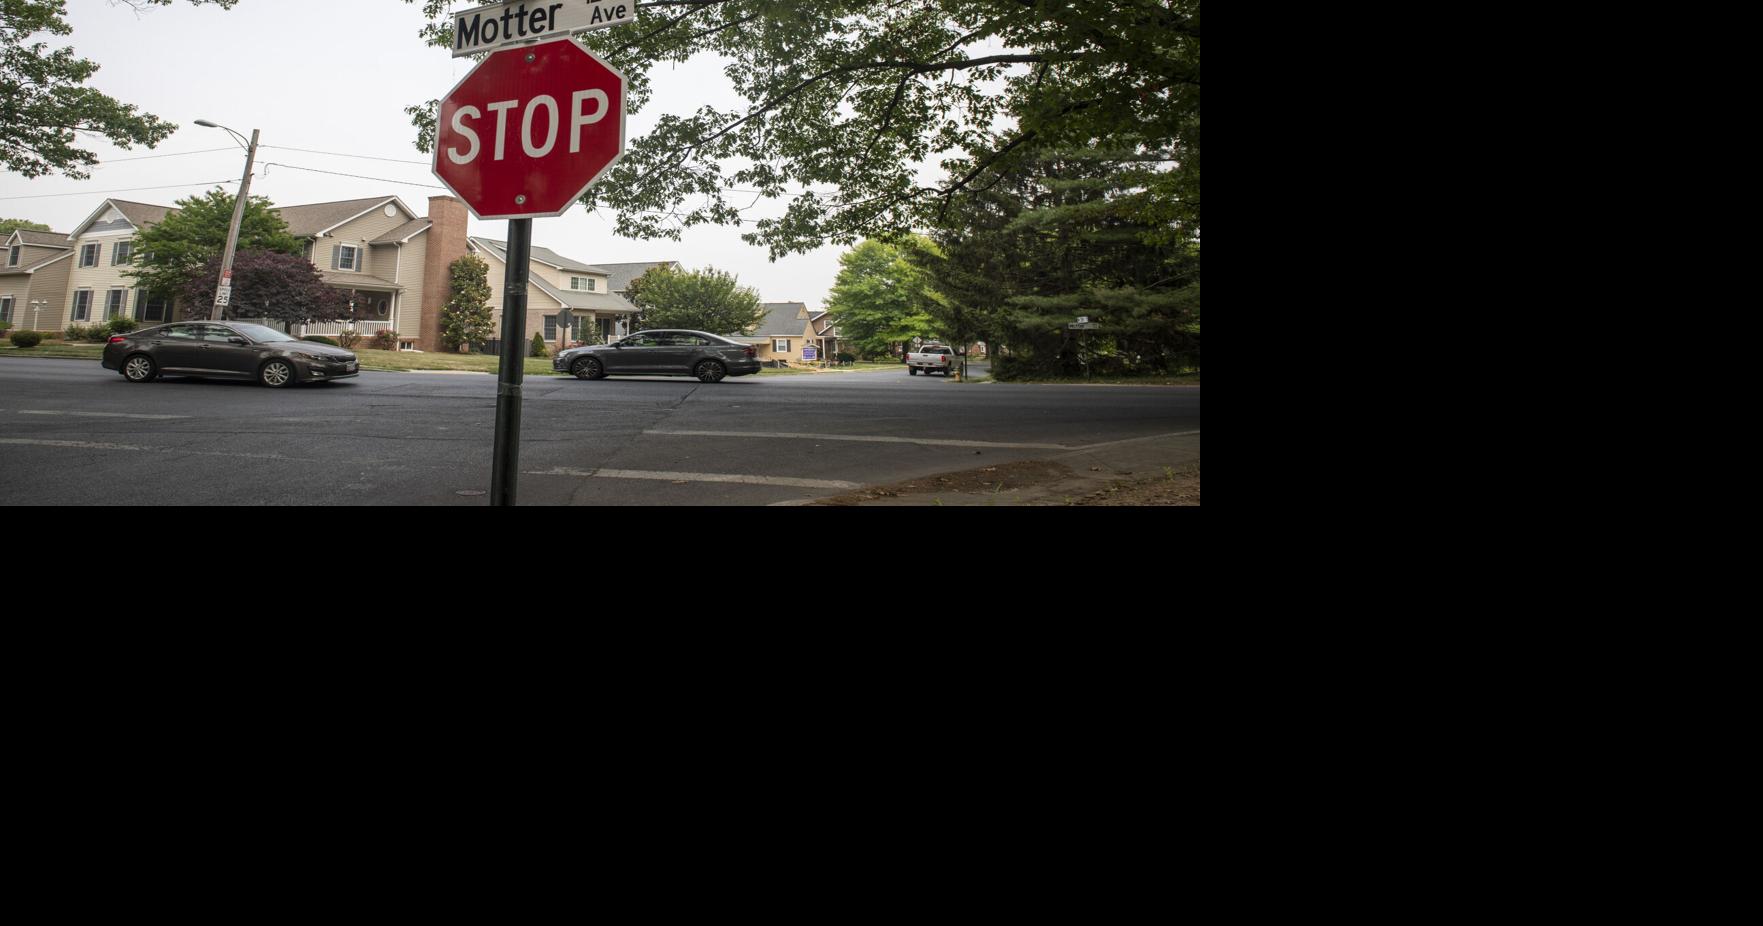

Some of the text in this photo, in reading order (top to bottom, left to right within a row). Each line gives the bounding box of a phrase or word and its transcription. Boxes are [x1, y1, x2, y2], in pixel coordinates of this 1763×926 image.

[457, 3, 627, 49] Motter Ave
[447, 88, 609, 165] STOP
[216, 295, 229, 304] 25
